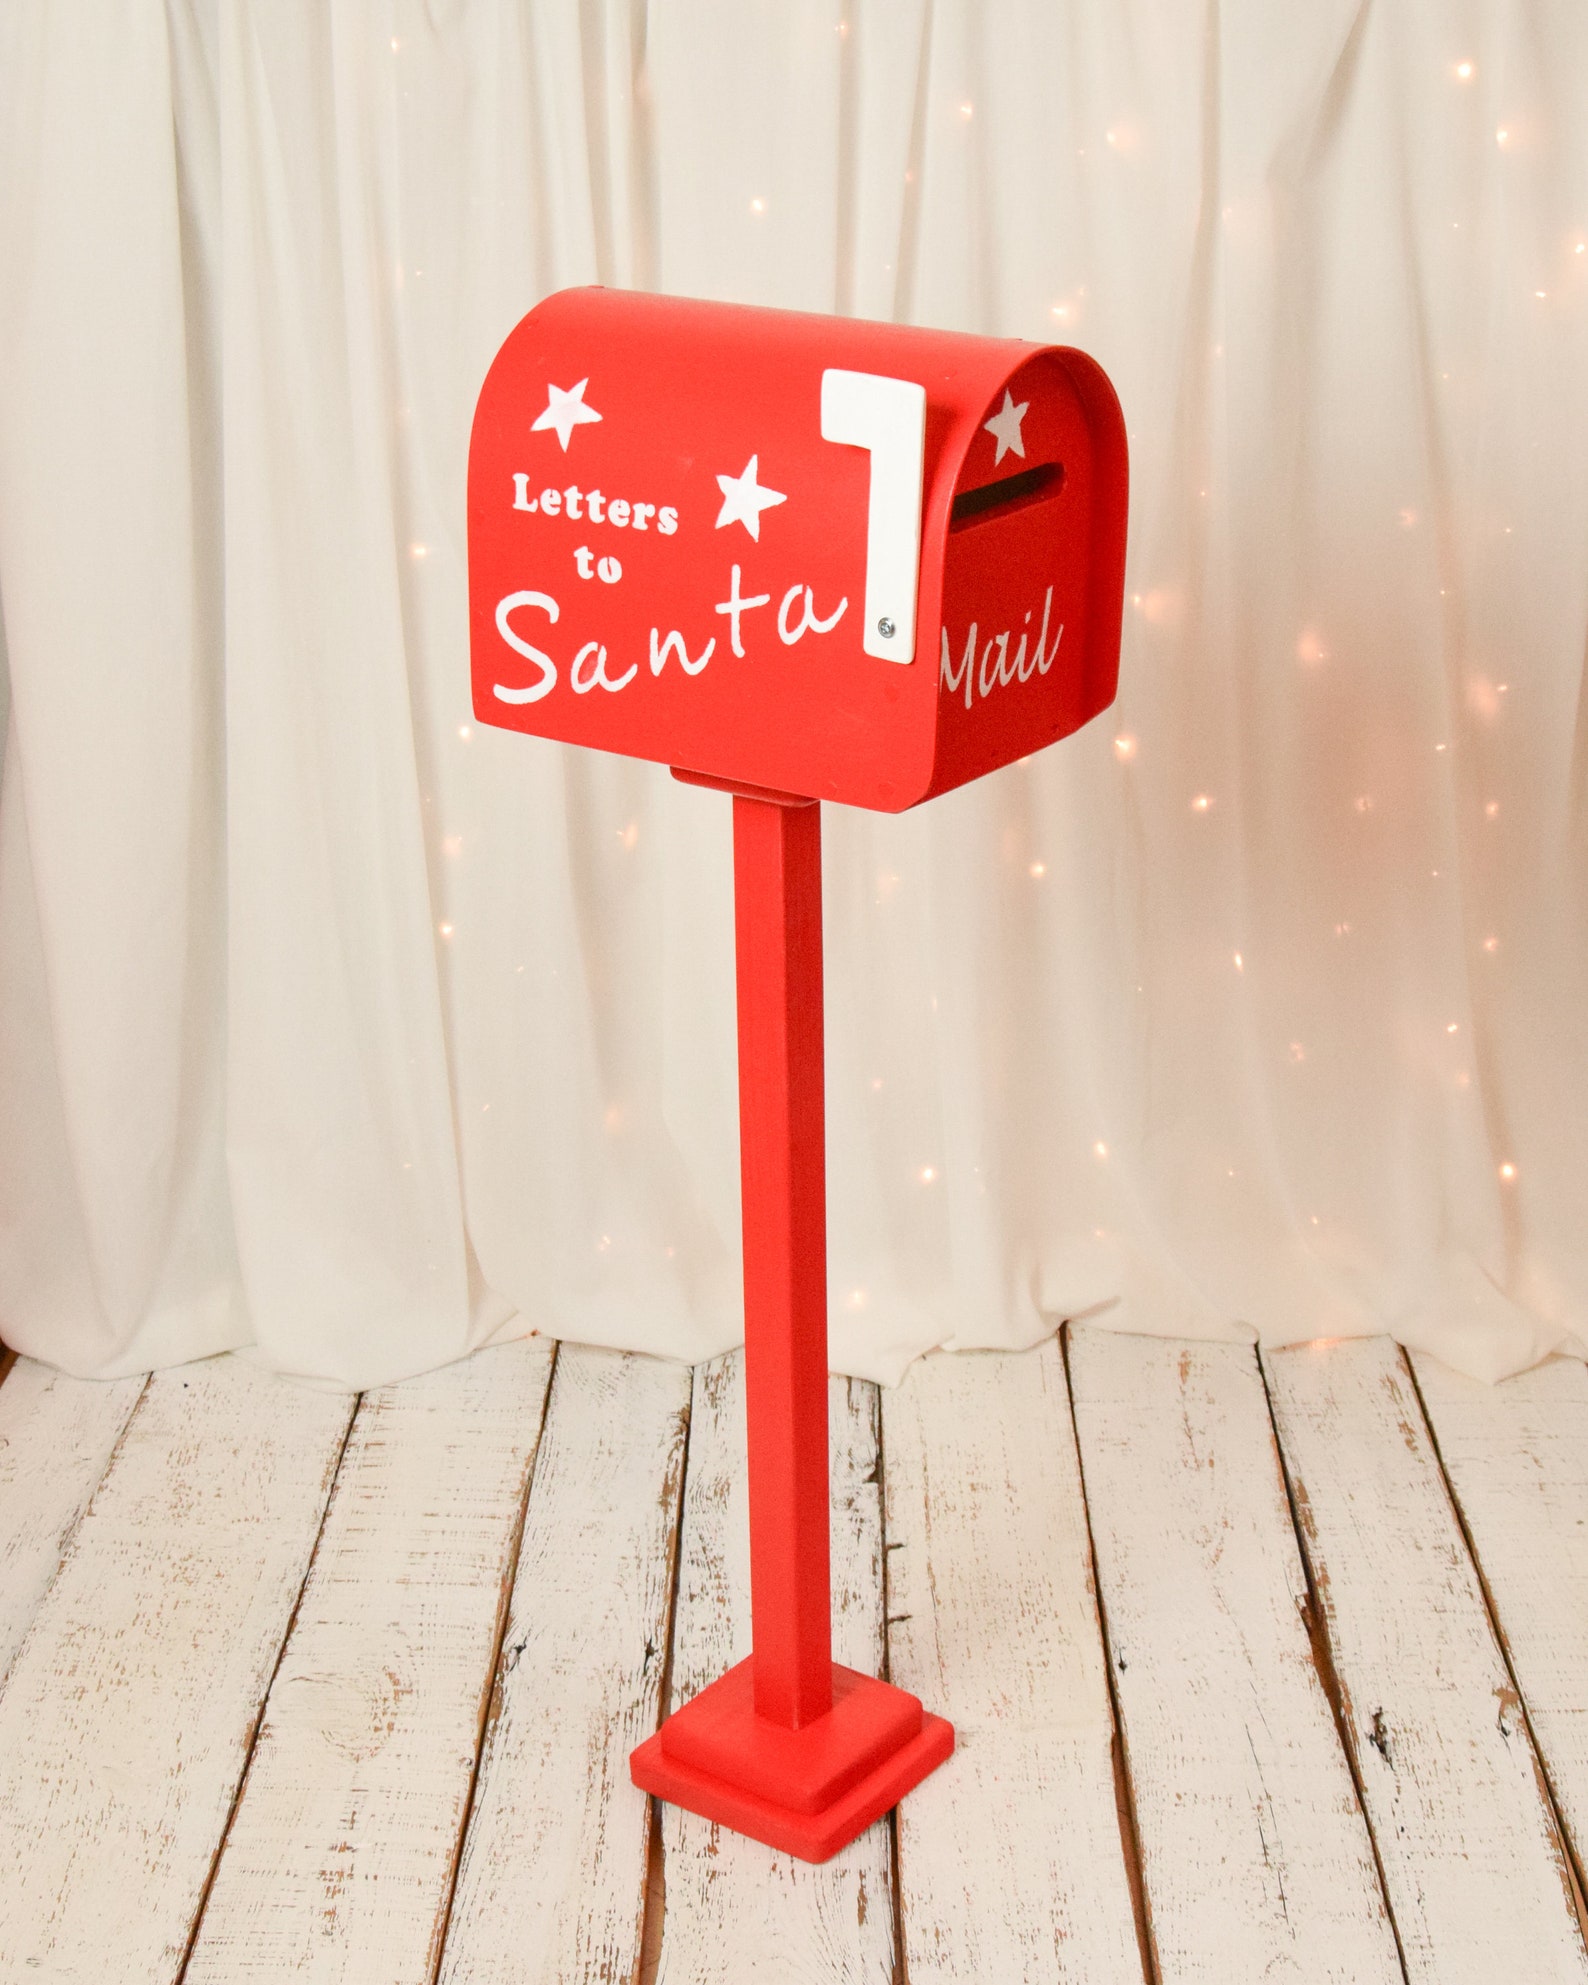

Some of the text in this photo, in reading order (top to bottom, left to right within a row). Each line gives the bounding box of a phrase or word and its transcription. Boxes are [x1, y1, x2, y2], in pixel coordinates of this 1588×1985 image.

[512, 472, 679, 536] Letters
[573, 545, 623, 584] to
[492, 563, 849, 706] Santa
[939, 585, 1064, 710] Mail
